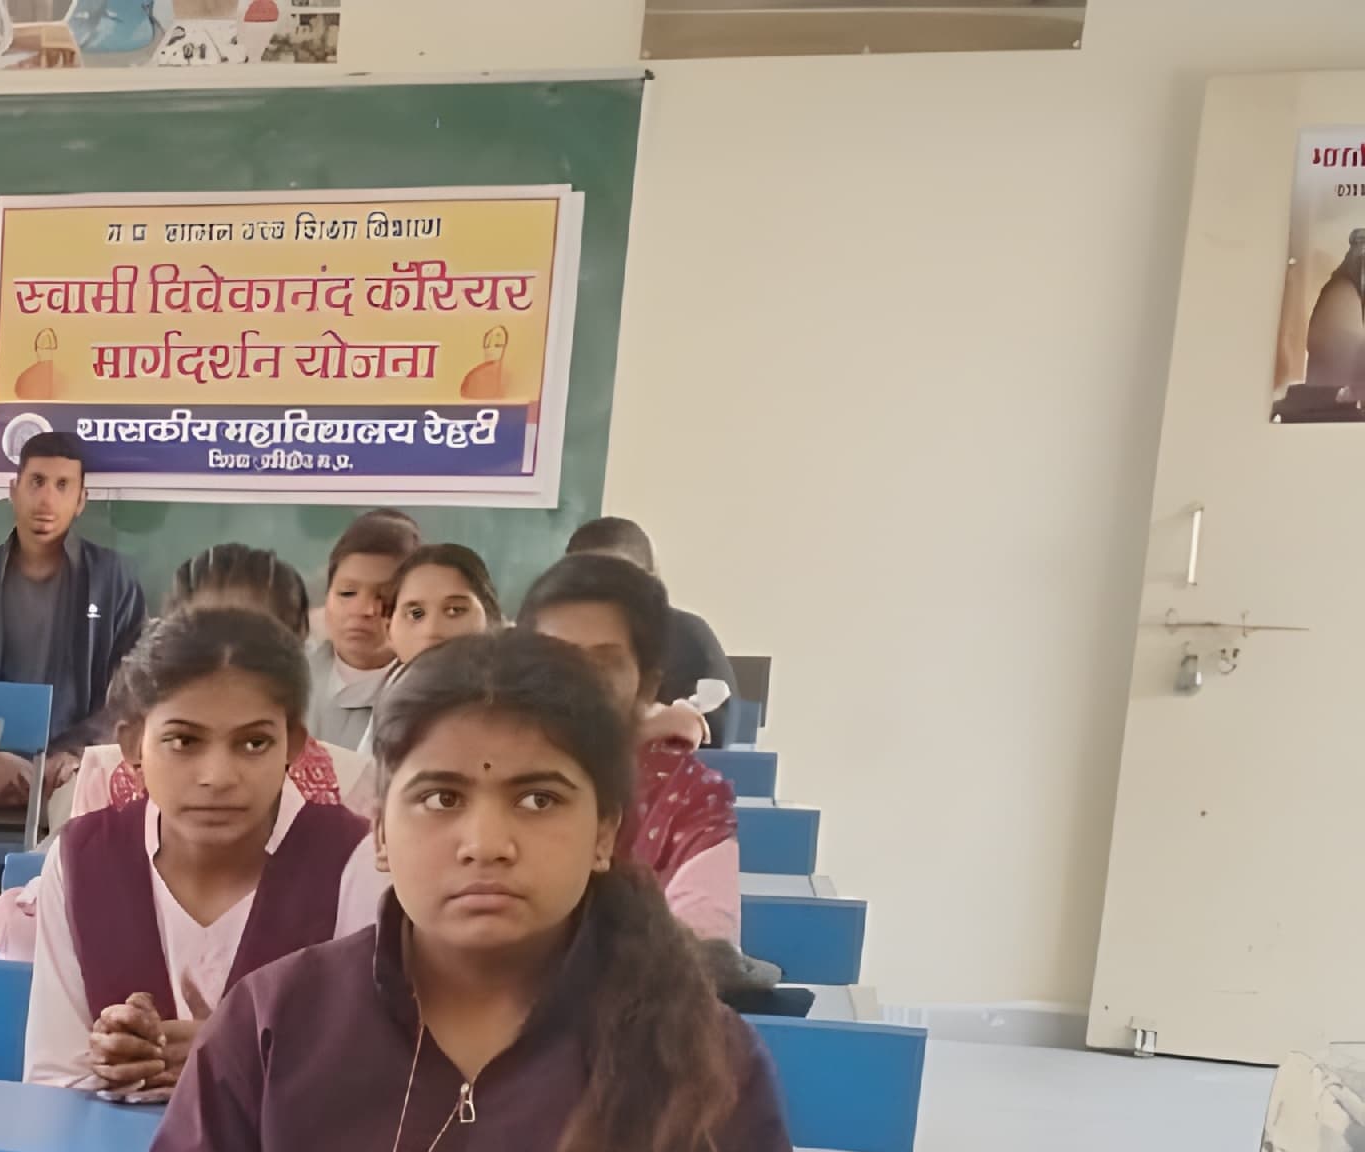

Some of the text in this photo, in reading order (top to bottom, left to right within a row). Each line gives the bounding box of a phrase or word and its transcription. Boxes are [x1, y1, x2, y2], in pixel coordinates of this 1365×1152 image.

[13, 265, 138, 314] स्वामी
[148, 263, 355, 316] विवेकानंद
[90, 329, 440, 384] मार्गदर्शन योजना
[76, 410, 500, 448] शासकीय महाविद्यालय रेहटी
